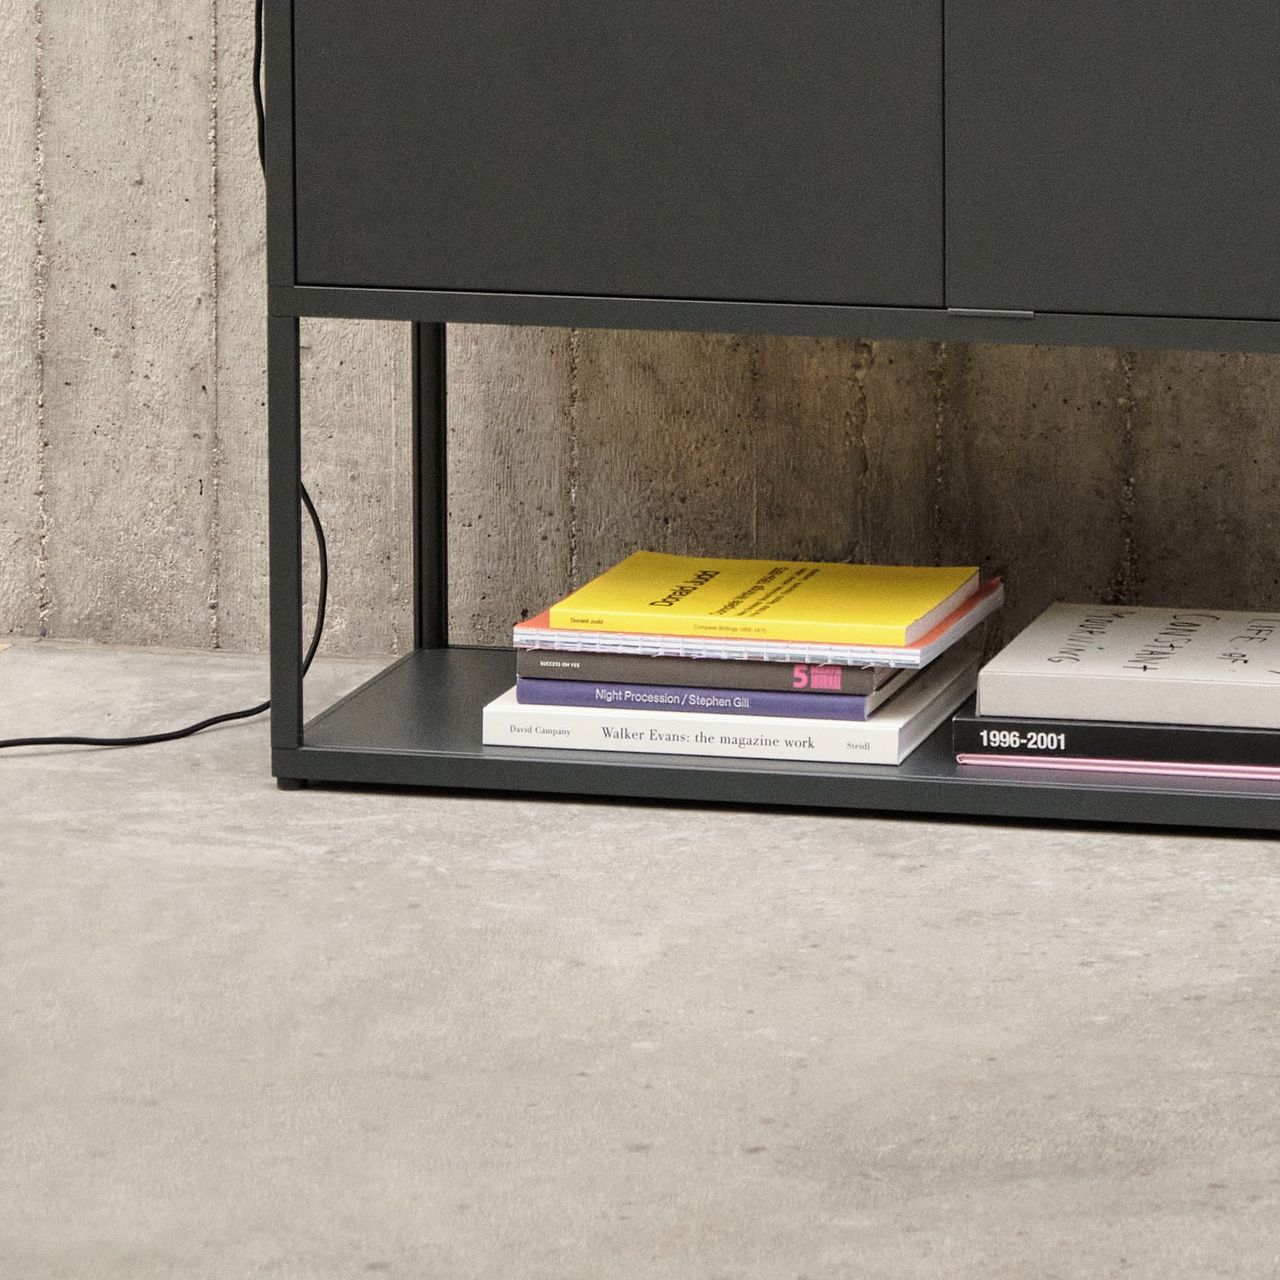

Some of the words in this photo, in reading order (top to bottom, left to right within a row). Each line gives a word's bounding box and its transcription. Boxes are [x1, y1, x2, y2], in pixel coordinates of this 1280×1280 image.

[648, 585, 699, 607] Donald
[682, 570, 721, 586] Judd
[540, 660, 561, 668] SUCCESS
[793, 663, 808, 689] 5
[595, 688, 623, 702] Night
[624, 690, 680, 705] Procession
[688, 694, 732, 708] Stephen
[733, 696, 750, 708] Gill
[509, 724, 533, 734] David
[534, 726, 571, 738] Campany
[602, 725, 646, 741] Walker
[649, 728, 691, 742] Evans:
[694, 730, 717, 744] the
[719, 734, 781, 749] magazine
[784, 735, 816, 749] work
[847, 741, 871, 751] Steidl
[980, 729, 1066, 751] 1996-2001
